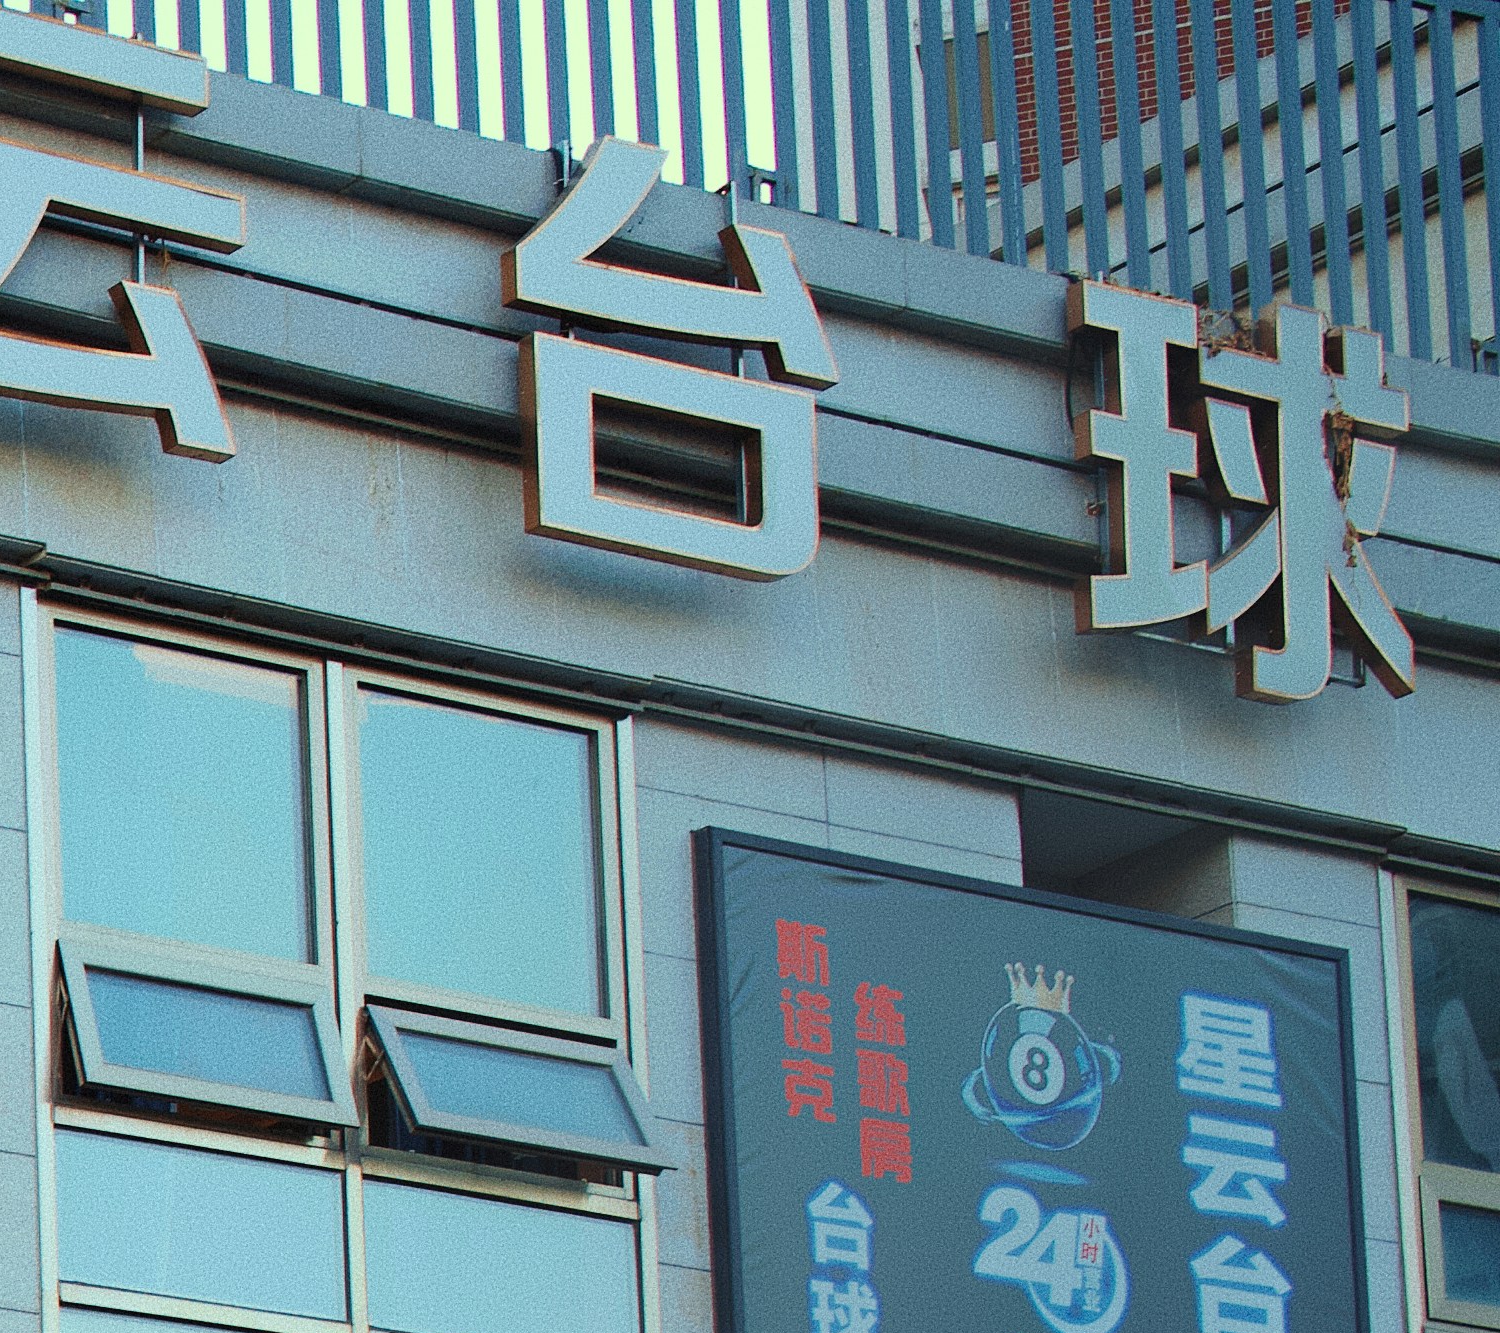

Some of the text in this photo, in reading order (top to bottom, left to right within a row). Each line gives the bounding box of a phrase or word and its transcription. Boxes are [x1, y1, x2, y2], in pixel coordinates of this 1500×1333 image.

[775, 918, 837, 1123] 斯诺克
[973, 1186, 1084, 1307] 24
[1080, 1217, 1100, 1264] 小时
